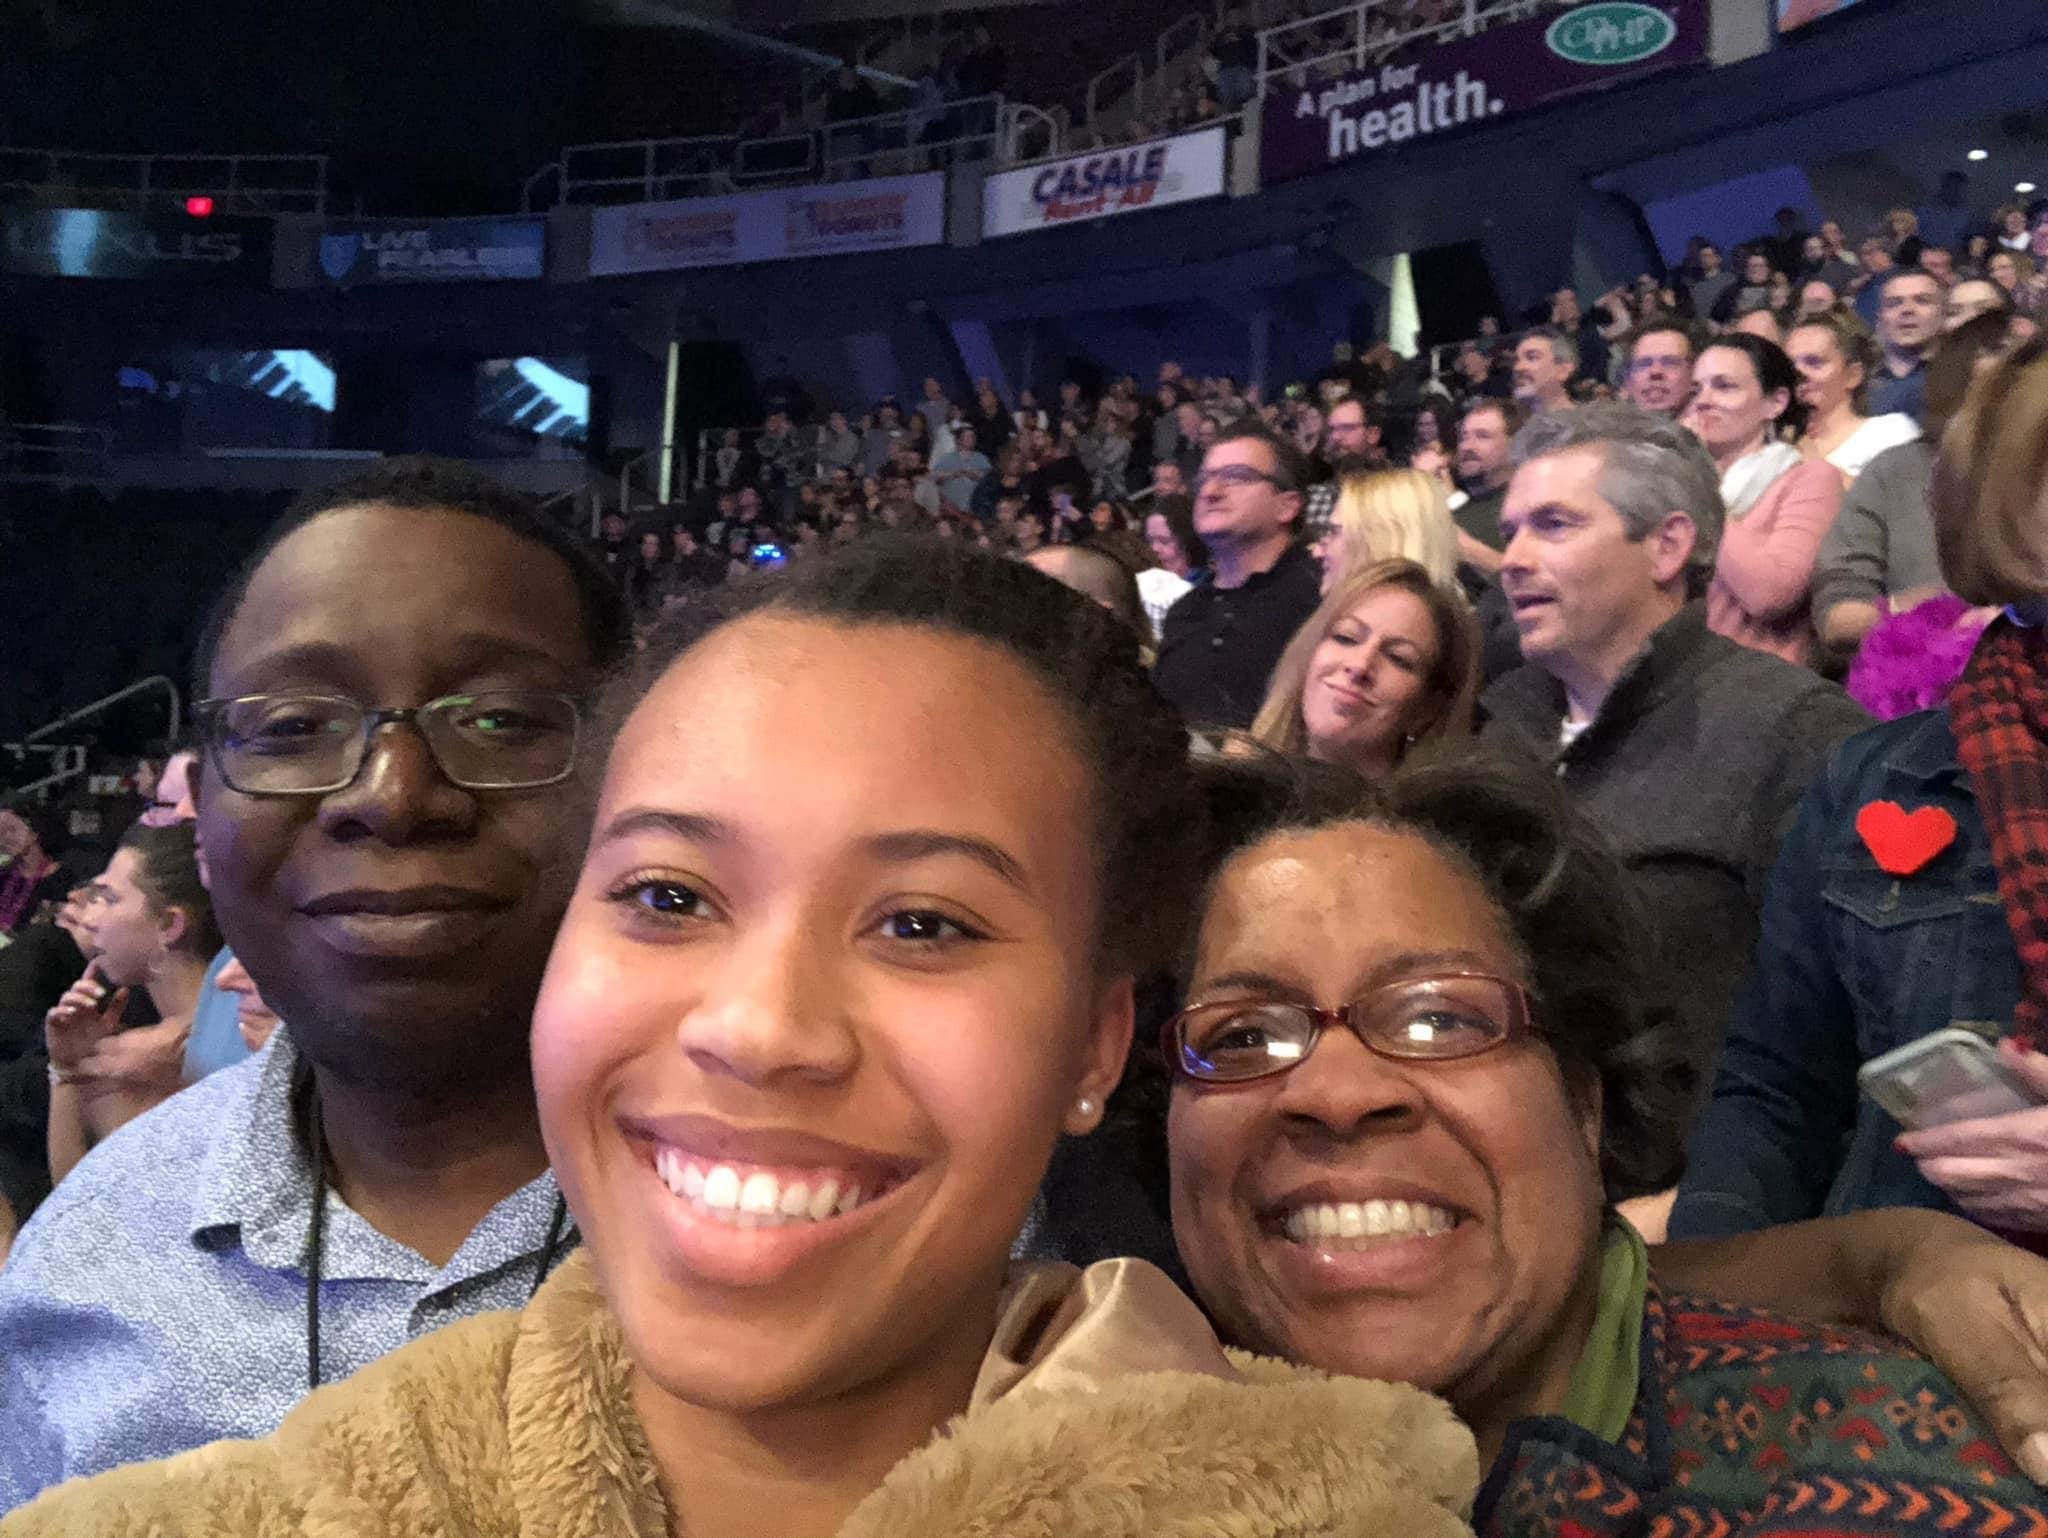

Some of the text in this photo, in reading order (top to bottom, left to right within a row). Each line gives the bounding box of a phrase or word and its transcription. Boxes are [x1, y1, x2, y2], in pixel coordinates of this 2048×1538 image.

[1295, 63, 1420, 118] A plan for
[1328, 70, 1505, 158] health.
[1032, 146, 1168, 204] CASALE
